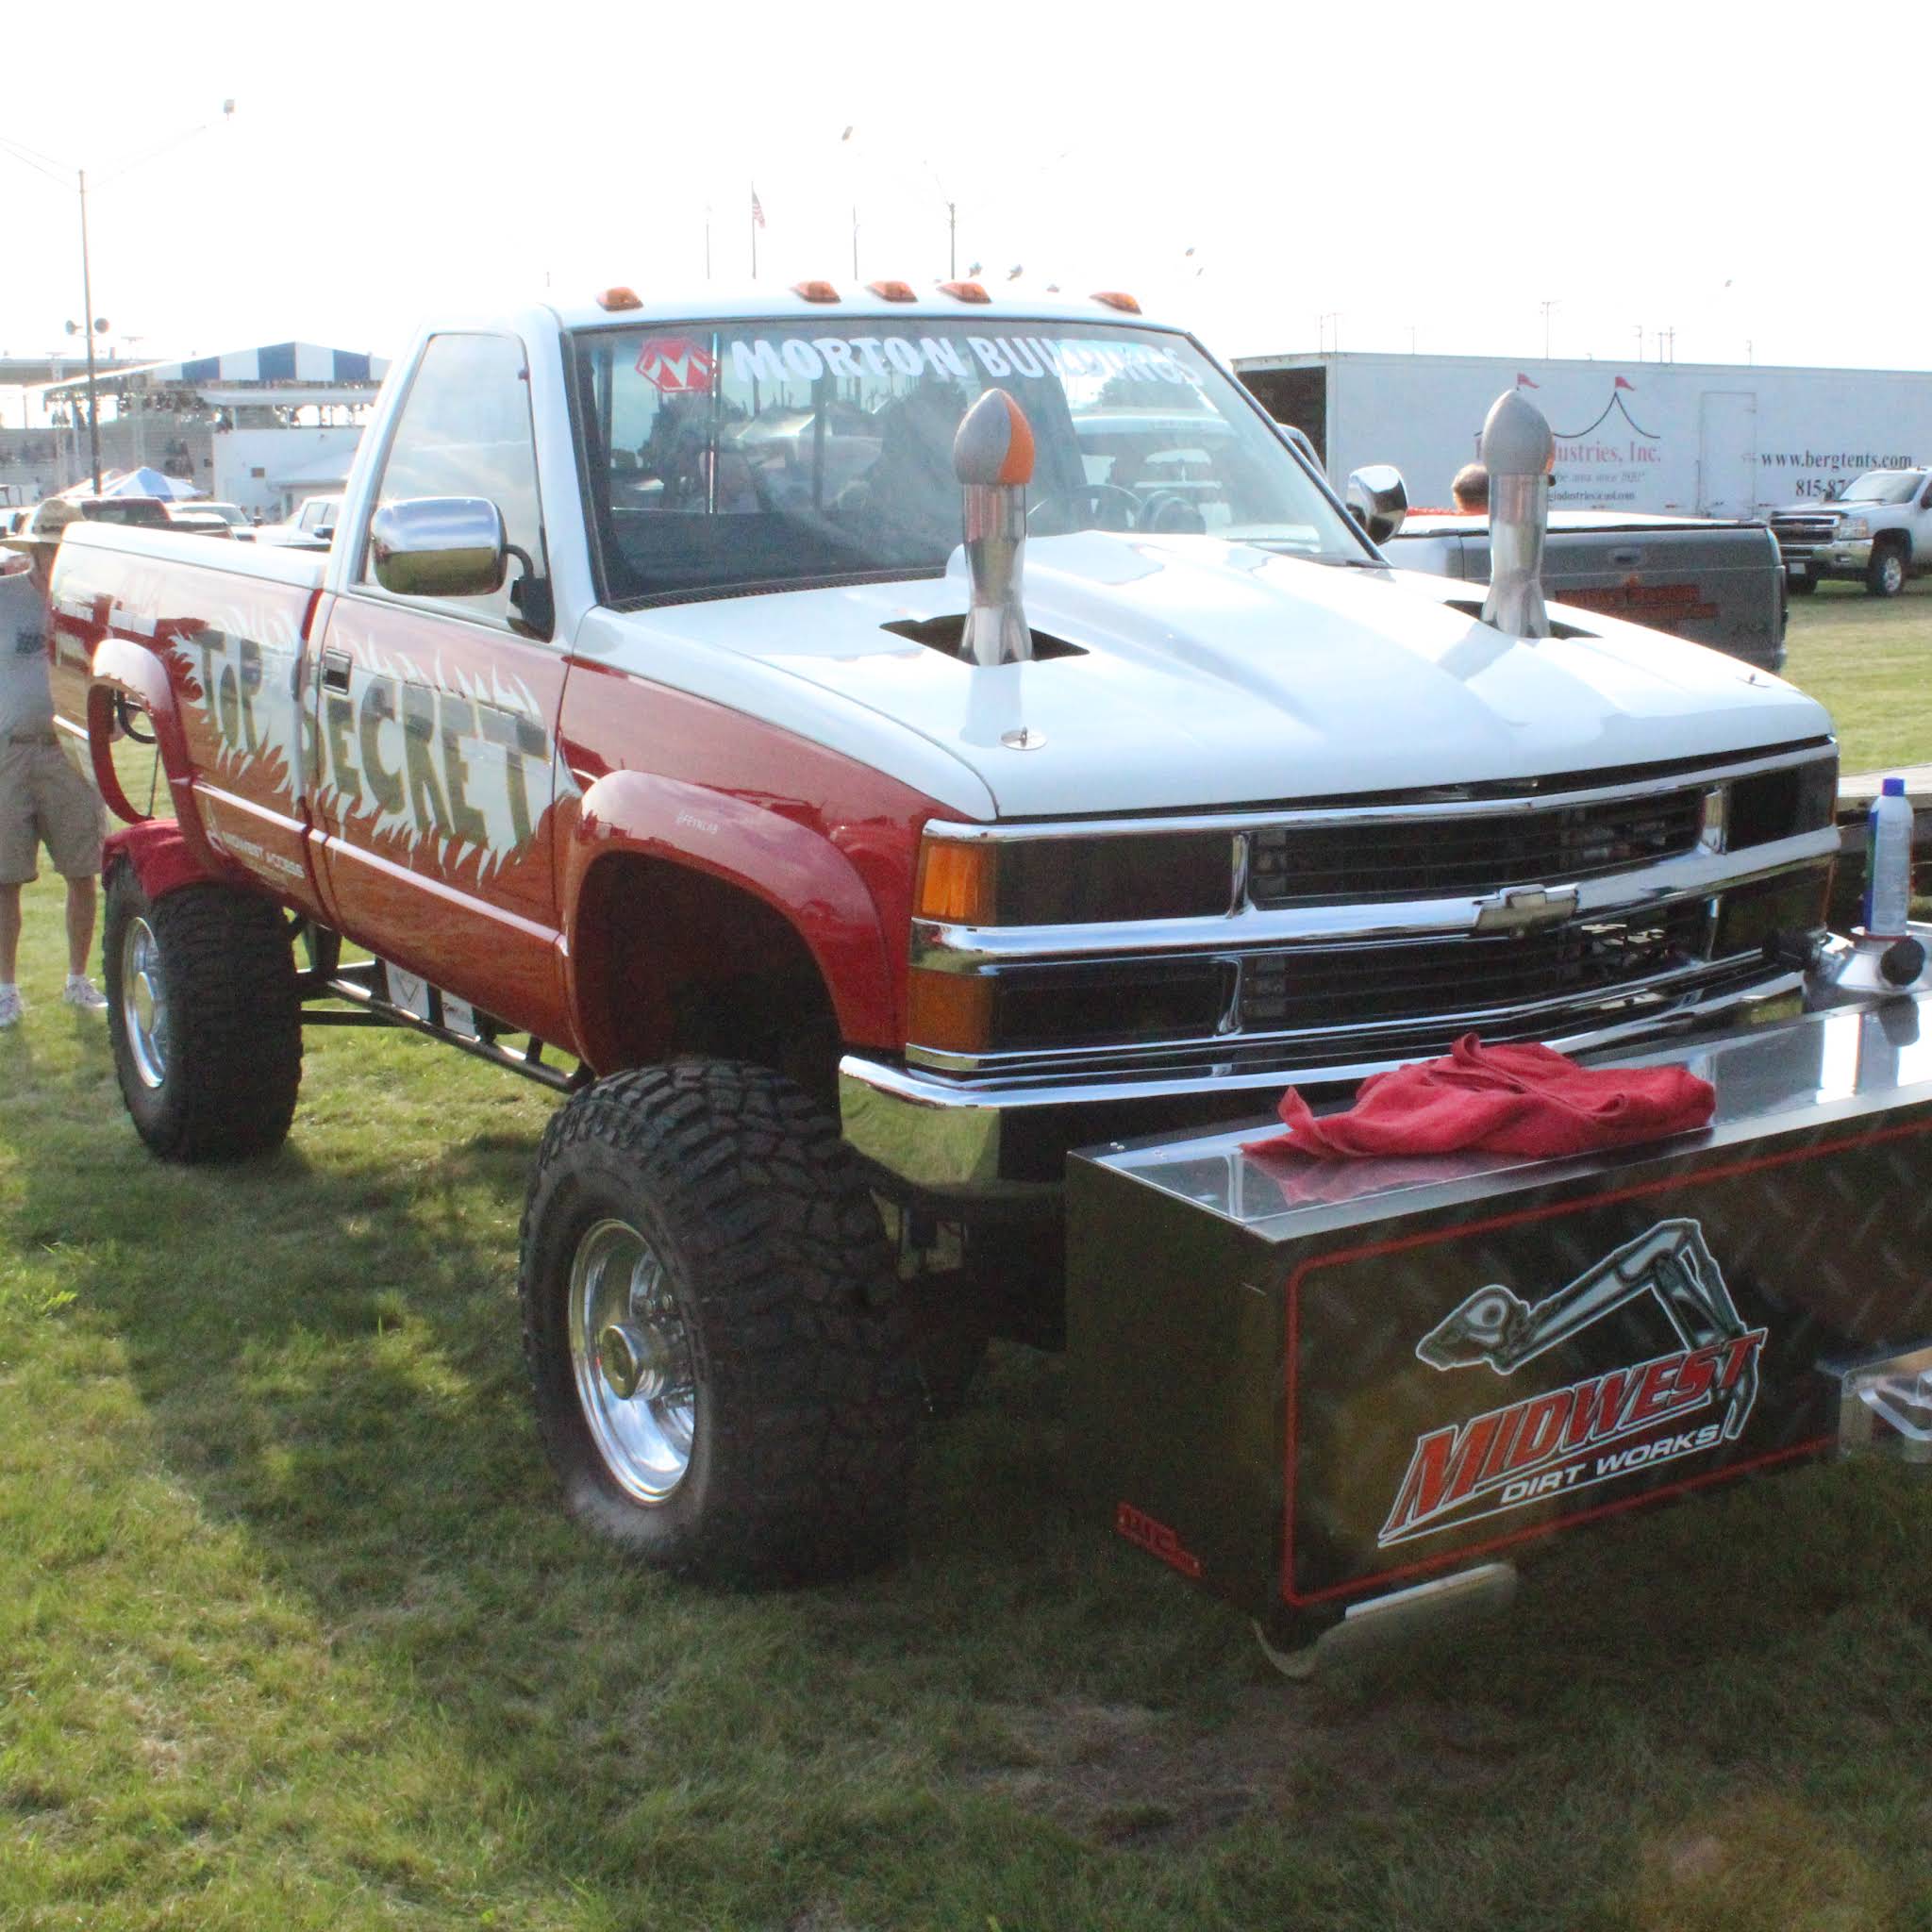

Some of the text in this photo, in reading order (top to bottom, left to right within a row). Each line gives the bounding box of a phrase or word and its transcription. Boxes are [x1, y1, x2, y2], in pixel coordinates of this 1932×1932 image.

[730, 337, 968, 383] MORTON
[1629, 441, 1661, 462] Inc.
[1760, 449, 1913, 473] www.bergtents.com
[290, 651, 549, 854] SECRET
[1379, 1328, 1768, 1541] MIDWEST
[1500, 1424, 1721, 1506] DIRT WORKS
